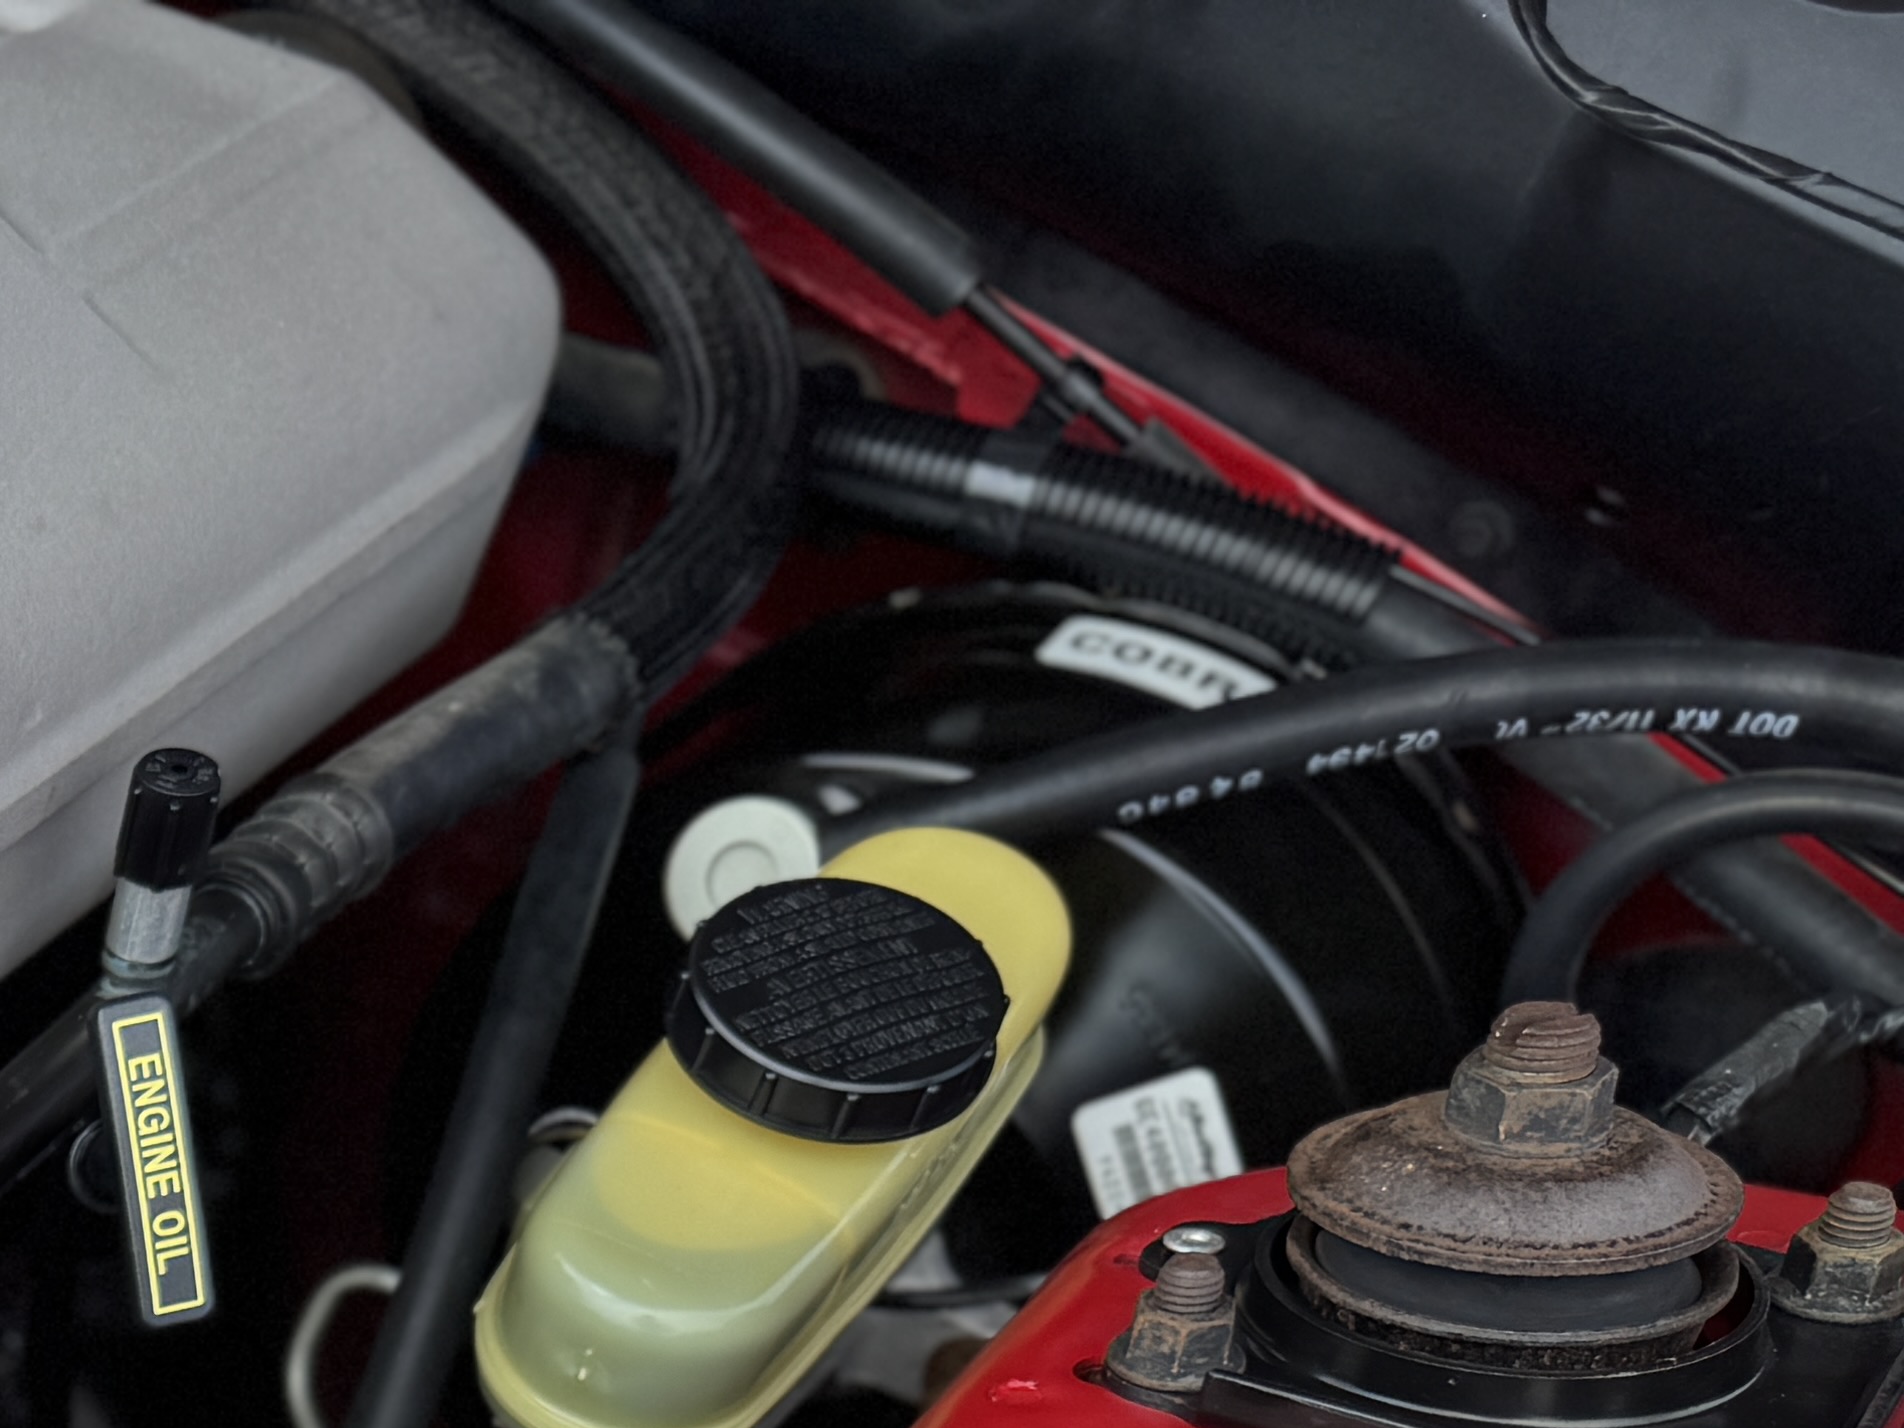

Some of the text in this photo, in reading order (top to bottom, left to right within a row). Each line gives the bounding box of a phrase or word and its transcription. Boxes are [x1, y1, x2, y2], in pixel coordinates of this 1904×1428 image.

[1070, 630, 1240, 702] COBR
[127, 1051, 190, 1277] ENGINE OIL
